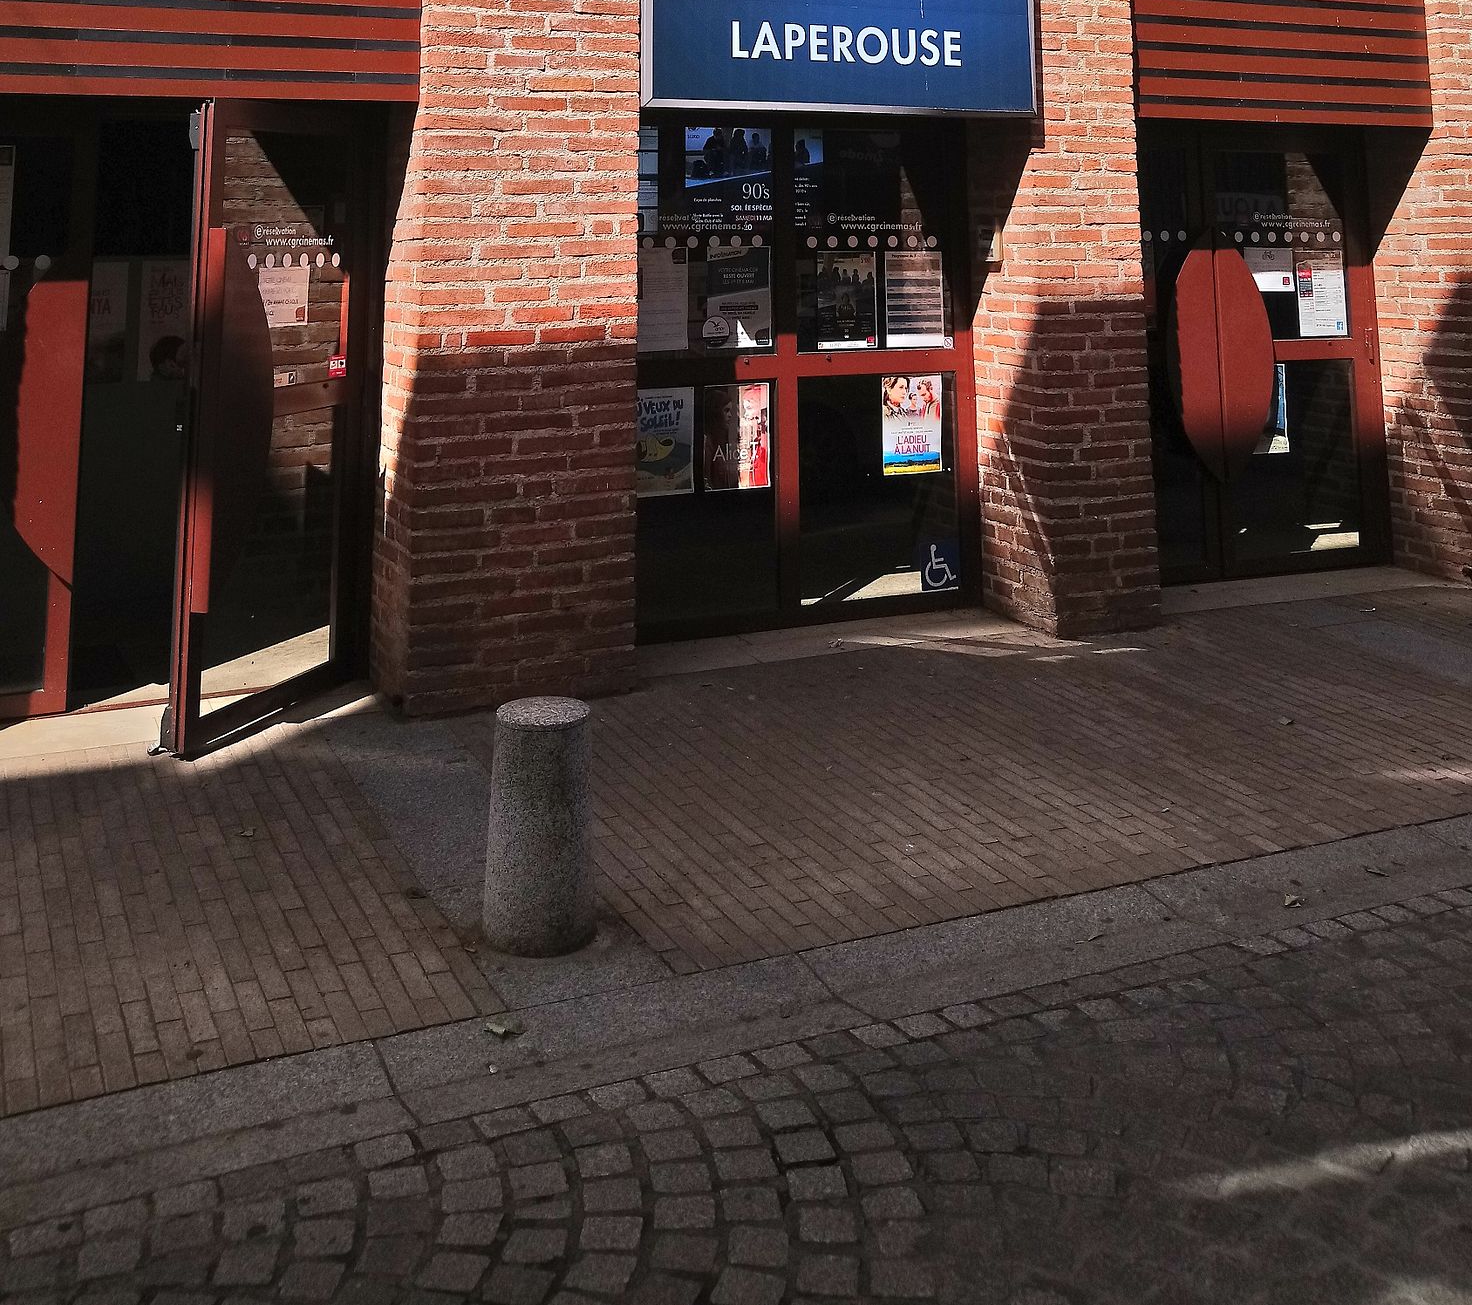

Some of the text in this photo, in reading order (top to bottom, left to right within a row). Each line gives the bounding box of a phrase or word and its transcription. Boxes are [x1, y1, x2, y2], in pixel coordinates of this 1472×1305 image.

[731, 20, 962, 67] LAPEROUSE
[742, 183, 770, 199] 90's
[840, 221, 923, 232] www.cgrcinemas.fr
[1261, 220, 1331, 230] www.cgrcinemas.fr
[265, 235, 335, 248] www.cgrcinemas.fr
[673, 399, 684, 411] DU
[898, 435, 926, 444] L'ADIEU
[712, 443, 747, 463] Alice
[901, 445, 911, 454] LA
[913, 444, 930, 453] NUIT
